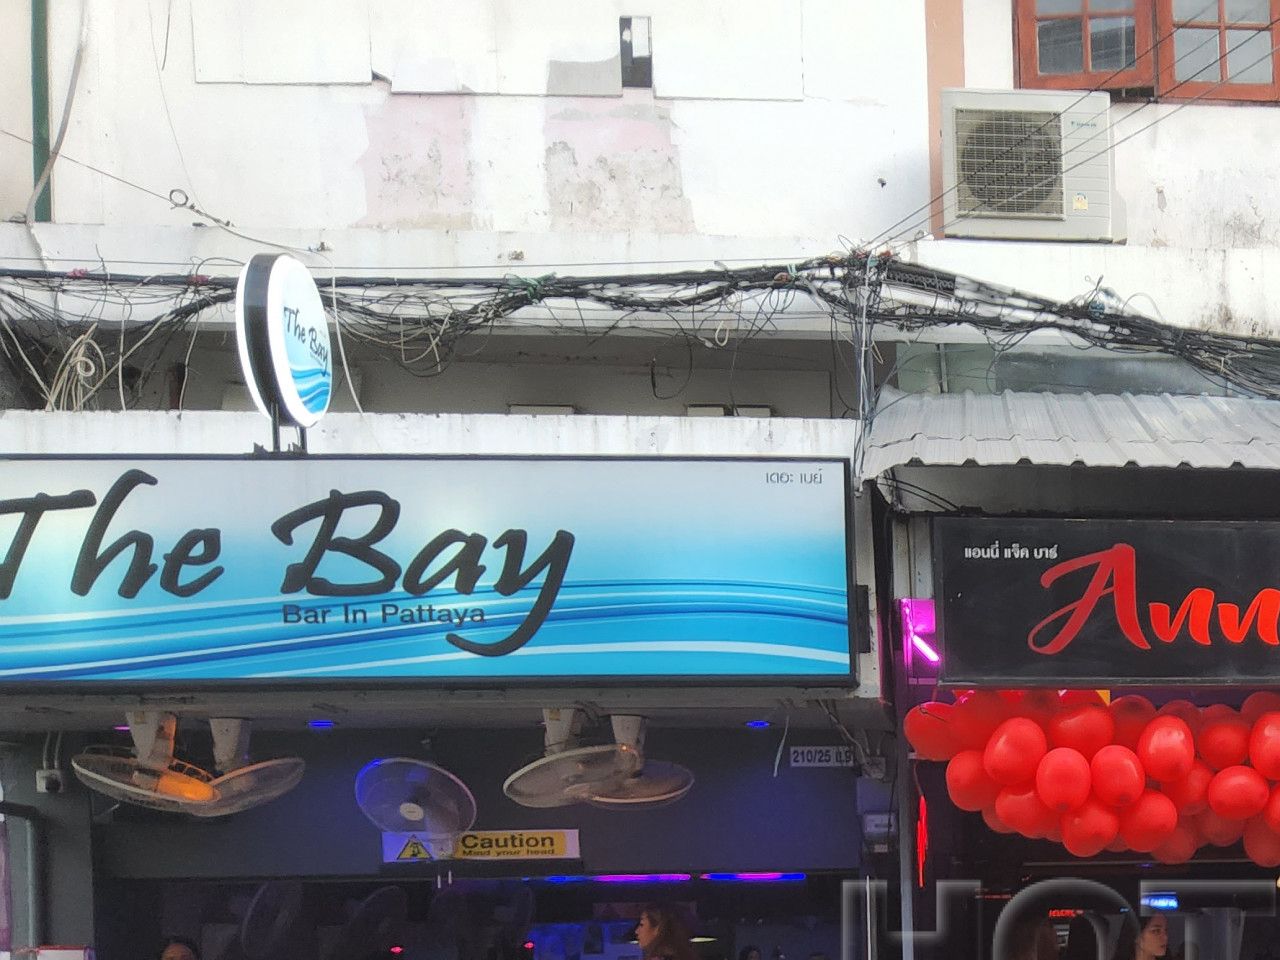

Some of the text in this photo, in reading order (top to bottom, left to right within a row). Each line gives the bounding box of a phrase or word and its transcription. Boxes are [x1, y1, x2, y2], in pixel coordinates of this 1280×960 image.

[284, 306, 306, 345] The
[308, 326, 329, 377] Bay
[964, 540, 1000, 559] แอนนี่
[0, 469, 575, 657] The Bay
[282, 604, 486, 626] Bar In Pattaya
[792, 749, 831, 763] 210/25
[461, 834, 555, 849] Caution
